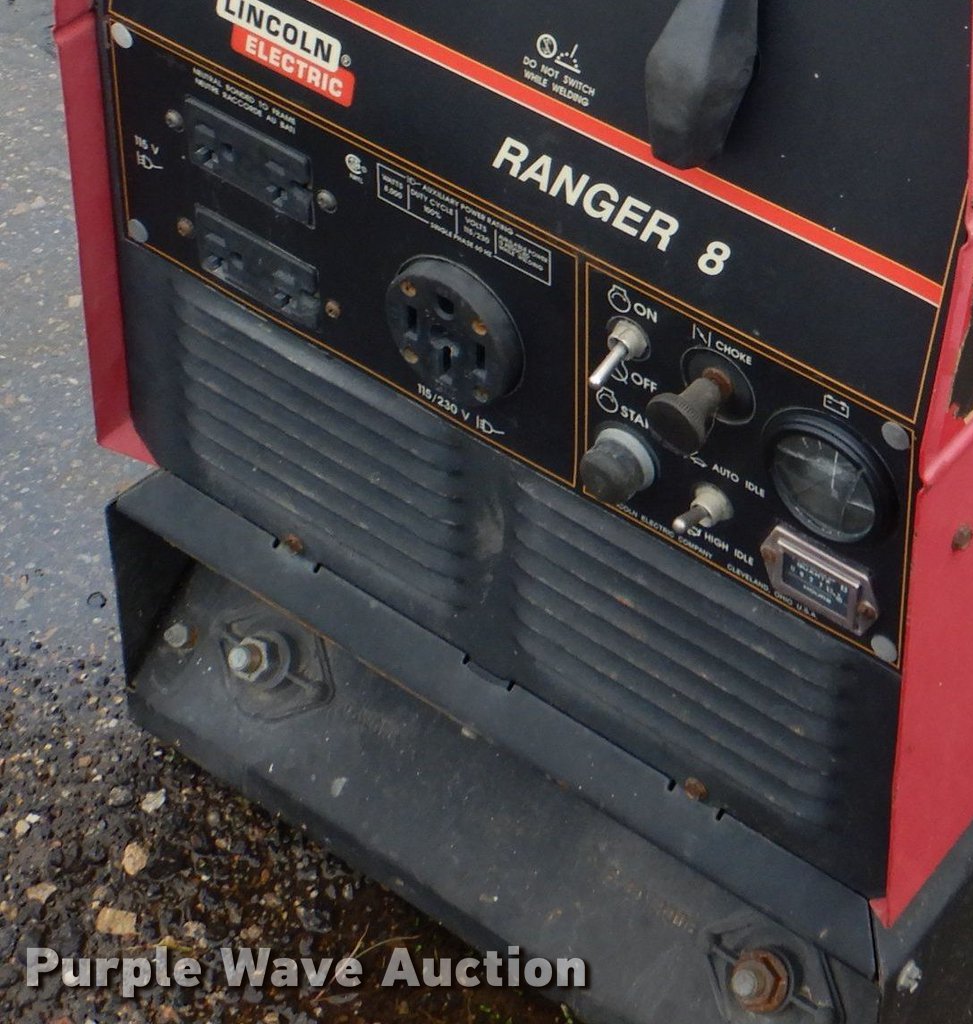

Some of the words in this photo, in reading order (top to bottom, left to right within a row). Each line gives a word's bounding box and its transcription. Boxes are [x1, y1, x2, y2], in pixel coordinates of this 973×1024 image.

[245, 34, 344, 98] ELECTRIC
[523, 56, 537, 68] DO
[540, 64, 559, 79] NOT
[563, 75, 596, 96] SWITCH
[524, 69, 548, 87] WHILE
[552, 82, 589, 107] WELDING
[134, 134, 149, 151] 115
[150, 142, 159, 155] V
[410, 188, 428, 203] DUTY
[429, 198, 453, 216] CYCLE
[422, 184, 459, 206] AUXILIARY
[460, 202, 486, 222] POWER
[486, 216, 514, 236] RATING
[492, 137, 679, 252] RANGER
[697, 241, 731, 276] 8
[465, 216, 487, 232] VOLTS
[633, 302, 657, 323] ON
[715, 341, 752, 366] CHOKE
[631, 372, 657, 392] OFF
[417, 383, 458, 415] 115/230
[461, 409, 470, 421] V
[620, 405, 649, 429] STA
[711, 463, 740, 484] AUTO
[745, 479, 765, 498] IDLE
[640, 515, 675, 538] ELECTRIC
[677, 536, 712, 559] COMPANY
[704, 532, 729, 552] HIGH
[734, 547, 754, 566] IDLE
